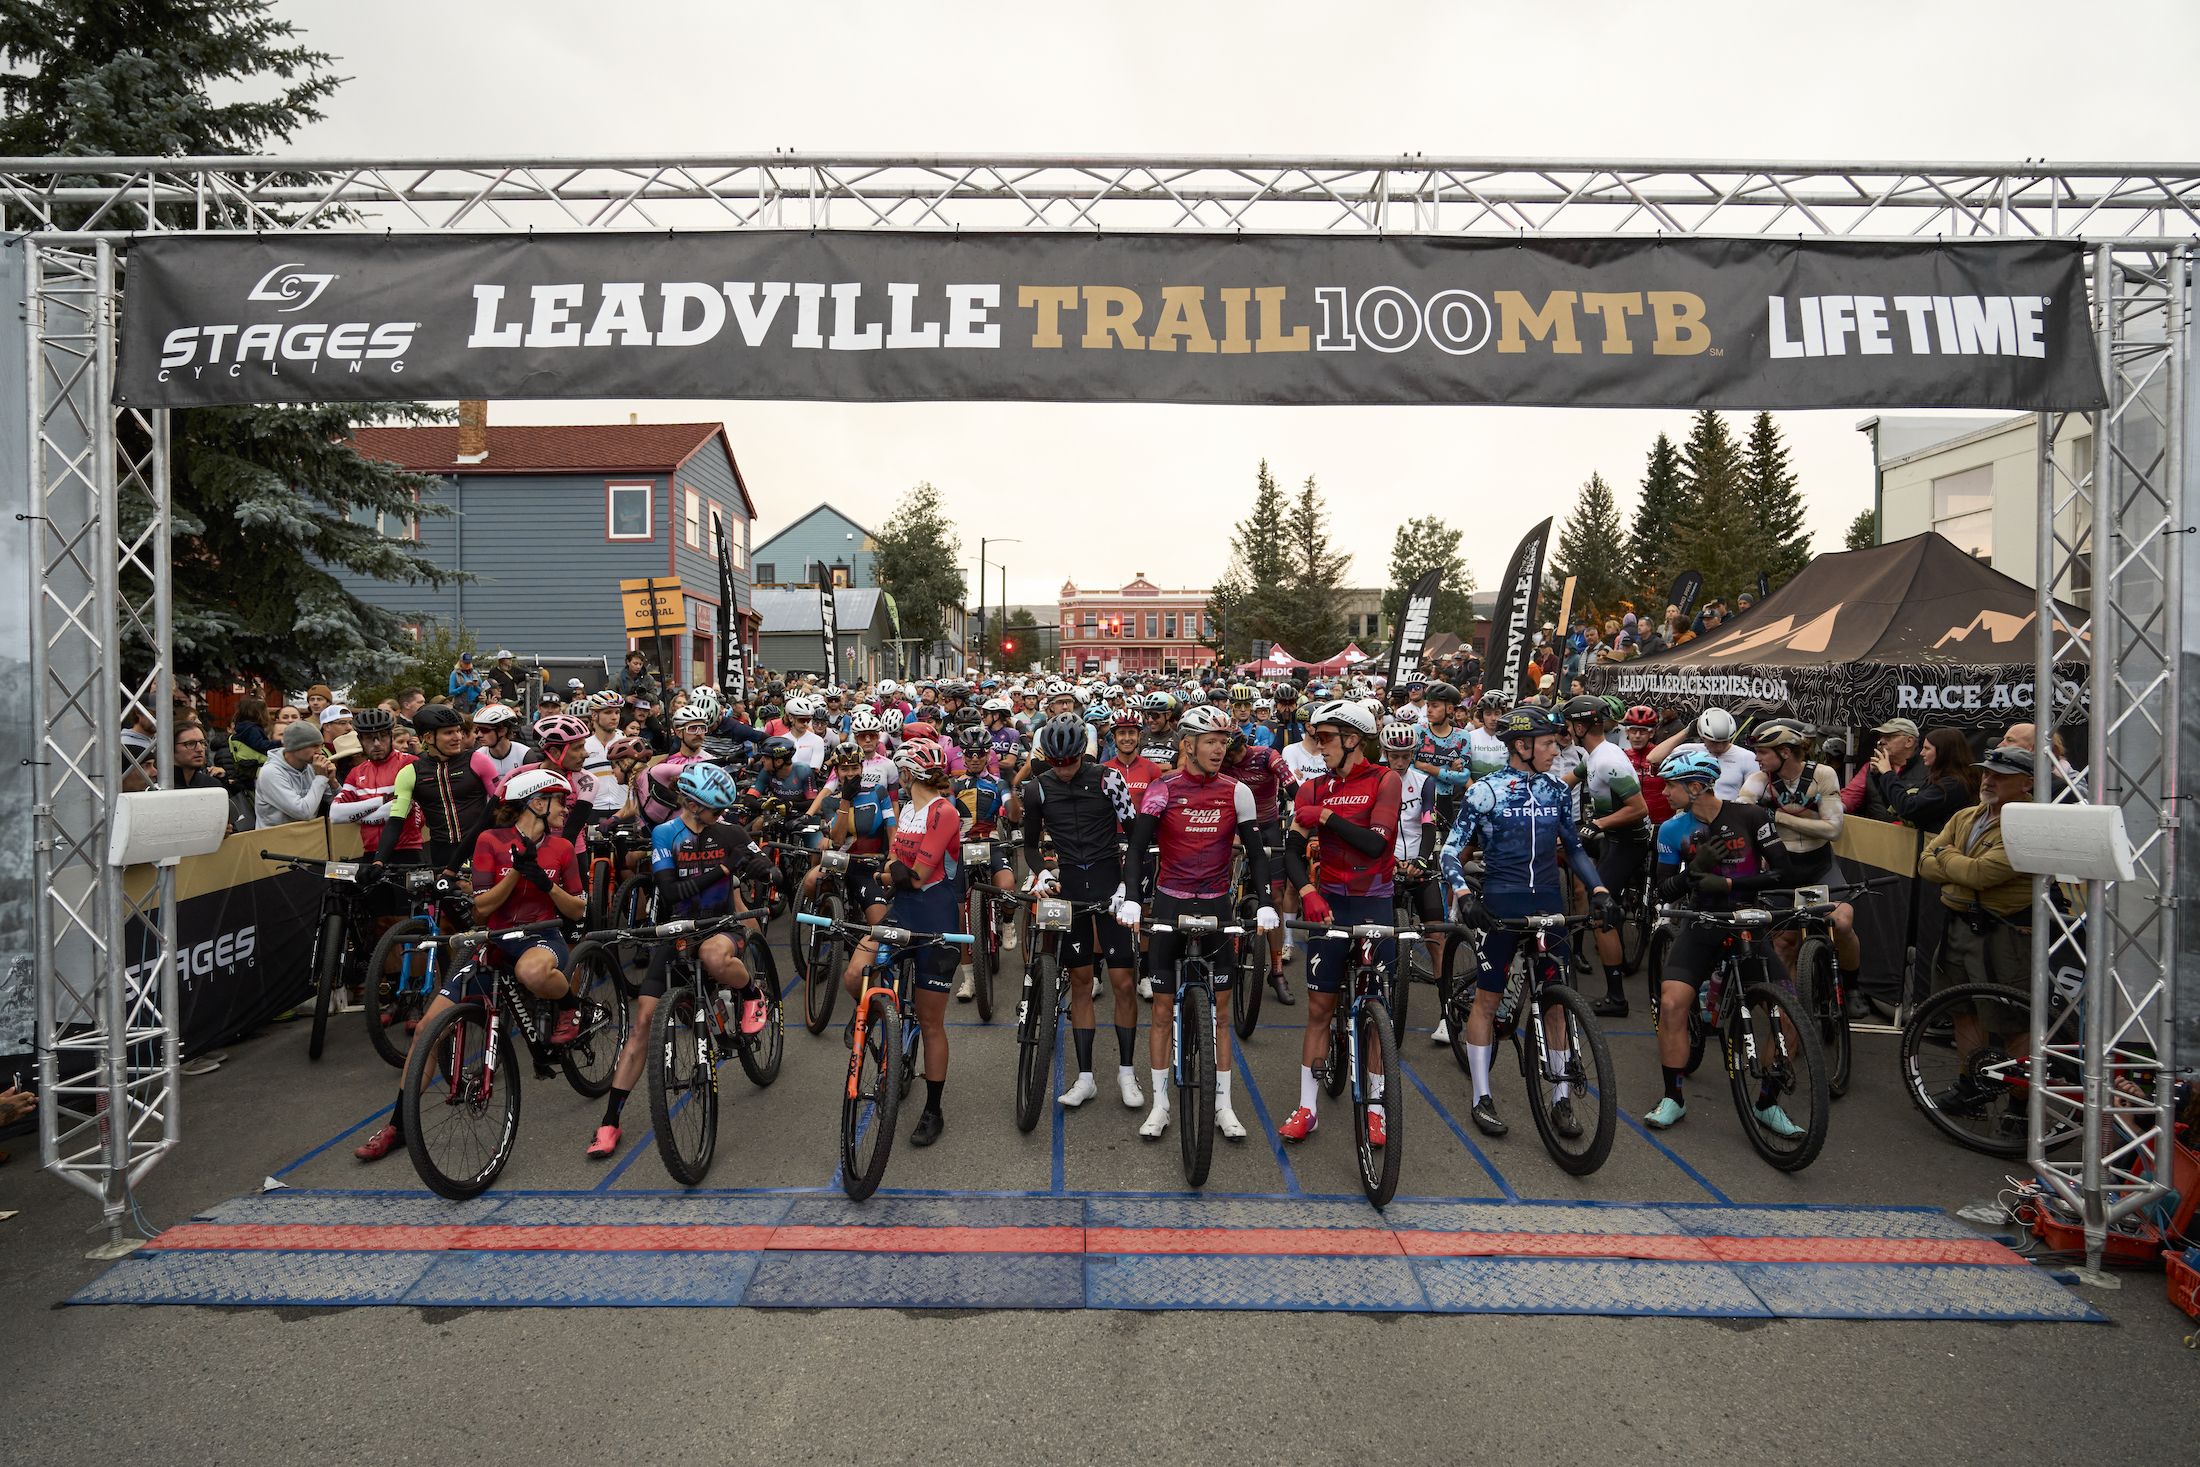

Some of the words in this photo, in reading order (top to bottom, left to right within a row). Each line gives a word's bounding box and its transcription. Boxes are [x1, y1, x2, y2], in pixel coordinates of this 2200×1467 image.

[467, 281, 1001, 351] LEADVILLE
[1018, 285, 1310, 354] TRAIL
[1314, 285, 1492, 356] 100
[1492, 289, 1712, 356] MTB
[1768, 295, 1889, 358] LIFE
[1893, 295, 2046, 359] TIME
[161, 321, 418, 368] STAGES
[158, 359, 404, 383] CYCLING
[635, 608, 674, 617] CORAL
[1400, 596, 1432, 654] TIME
[1262, 666, 1293, 677] MEDIC
[1617, 675, 1788, 700] LEADVILLERACESERIES.COM
[1897, 685, 1983, 709] RACE
[1334, 711, 1372, 733] SPECIALIZED
[518, 777, 557, 797] SPECIALIZED
[1322, 795, 1370, 806] SPECIALIZED
[1181, 808, 1221, 816] SANTA
[1502, 806, 1559, 818] STRAFE
[1189, 816, 1221, 824] CRUZ
[1580, 827, 1595, 836] FLY
[677, 848, 726, 862] MAXXIS
[971, 849, 982, 857] 34
[1047, 909, 1061, 918] 63
[1540, 918, 1554, 927] 95
[668, 924, 683, 934] 33
[883, 929, 898, 940] 28
[1366, 929, 1381, 939] 46
[501, 974, 539, 1043] S-WORKS
